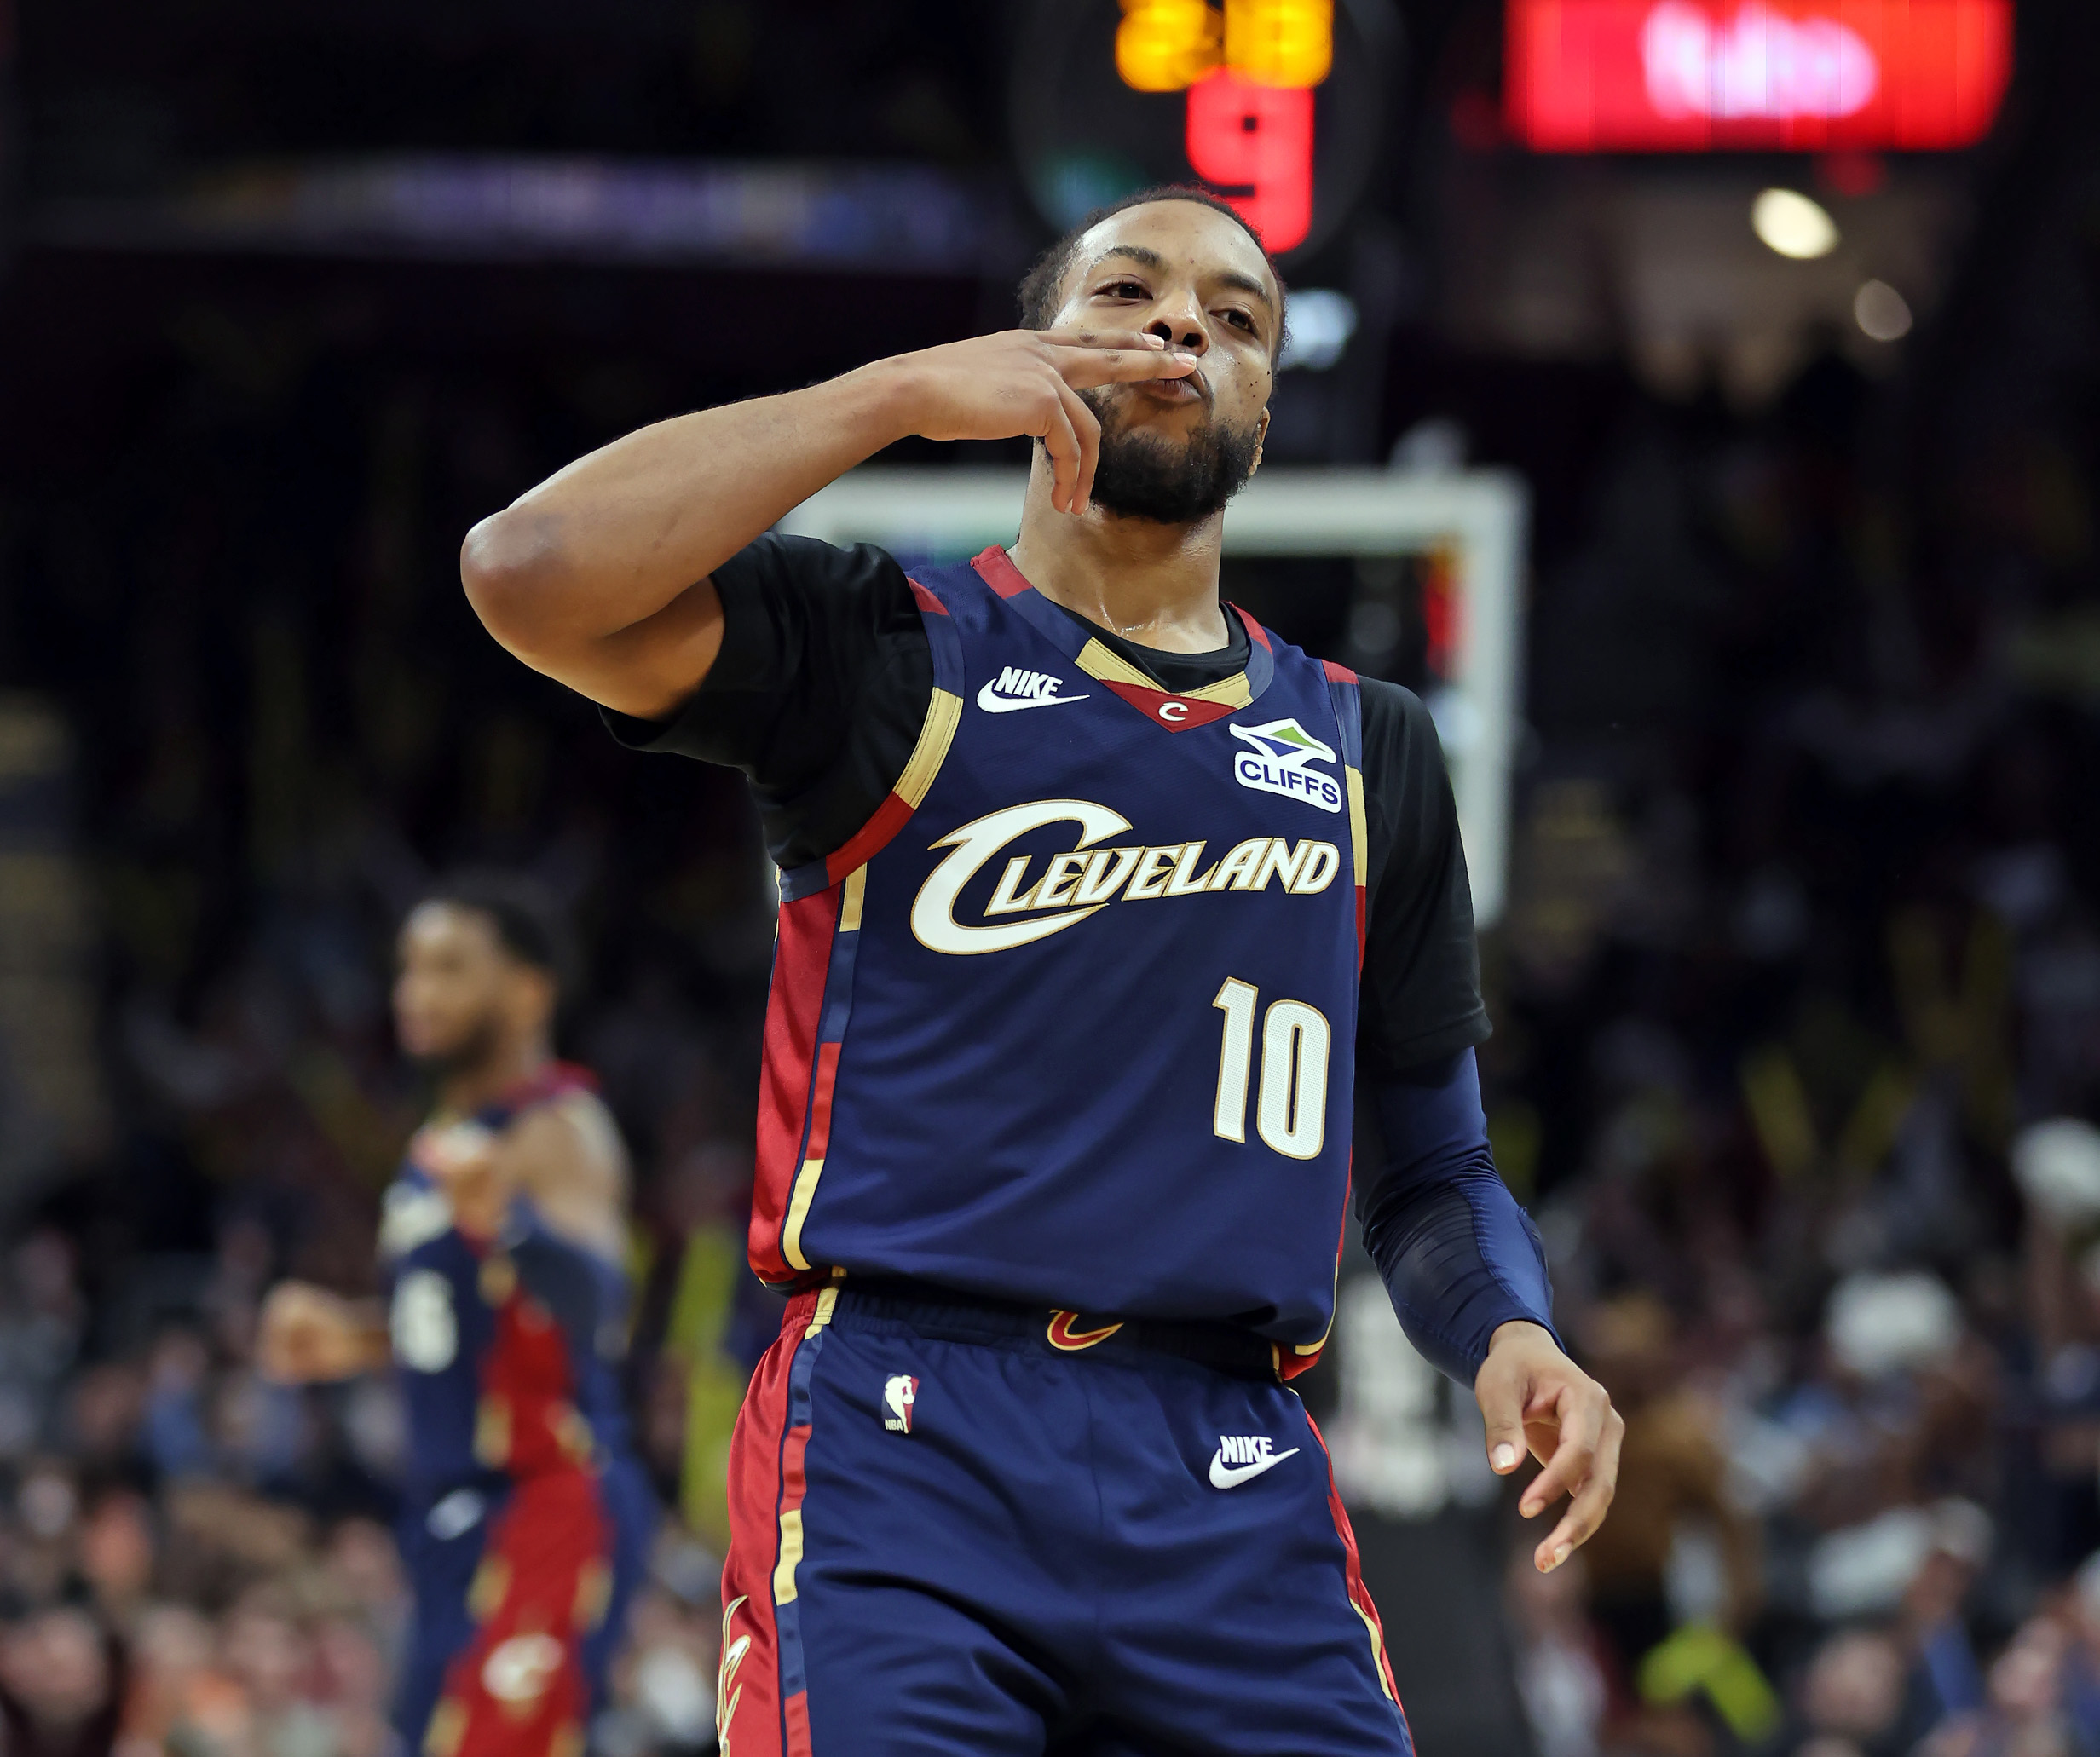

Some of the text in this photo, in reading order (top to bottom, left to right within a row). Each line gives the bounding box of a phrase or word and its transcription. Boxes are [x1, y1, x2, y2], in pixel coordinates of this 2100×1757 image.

[994, 665, 1064, 699] NIKE
[1240, 759, 1338, 805] CLIFFS
[910, 799, 1340, 955] CLEVELAND
[1212, 976, 1331, 1161] 10
[885, 1419, 903, 1431] NBA
[1219, 1435, 1275, 1464] NIKE
